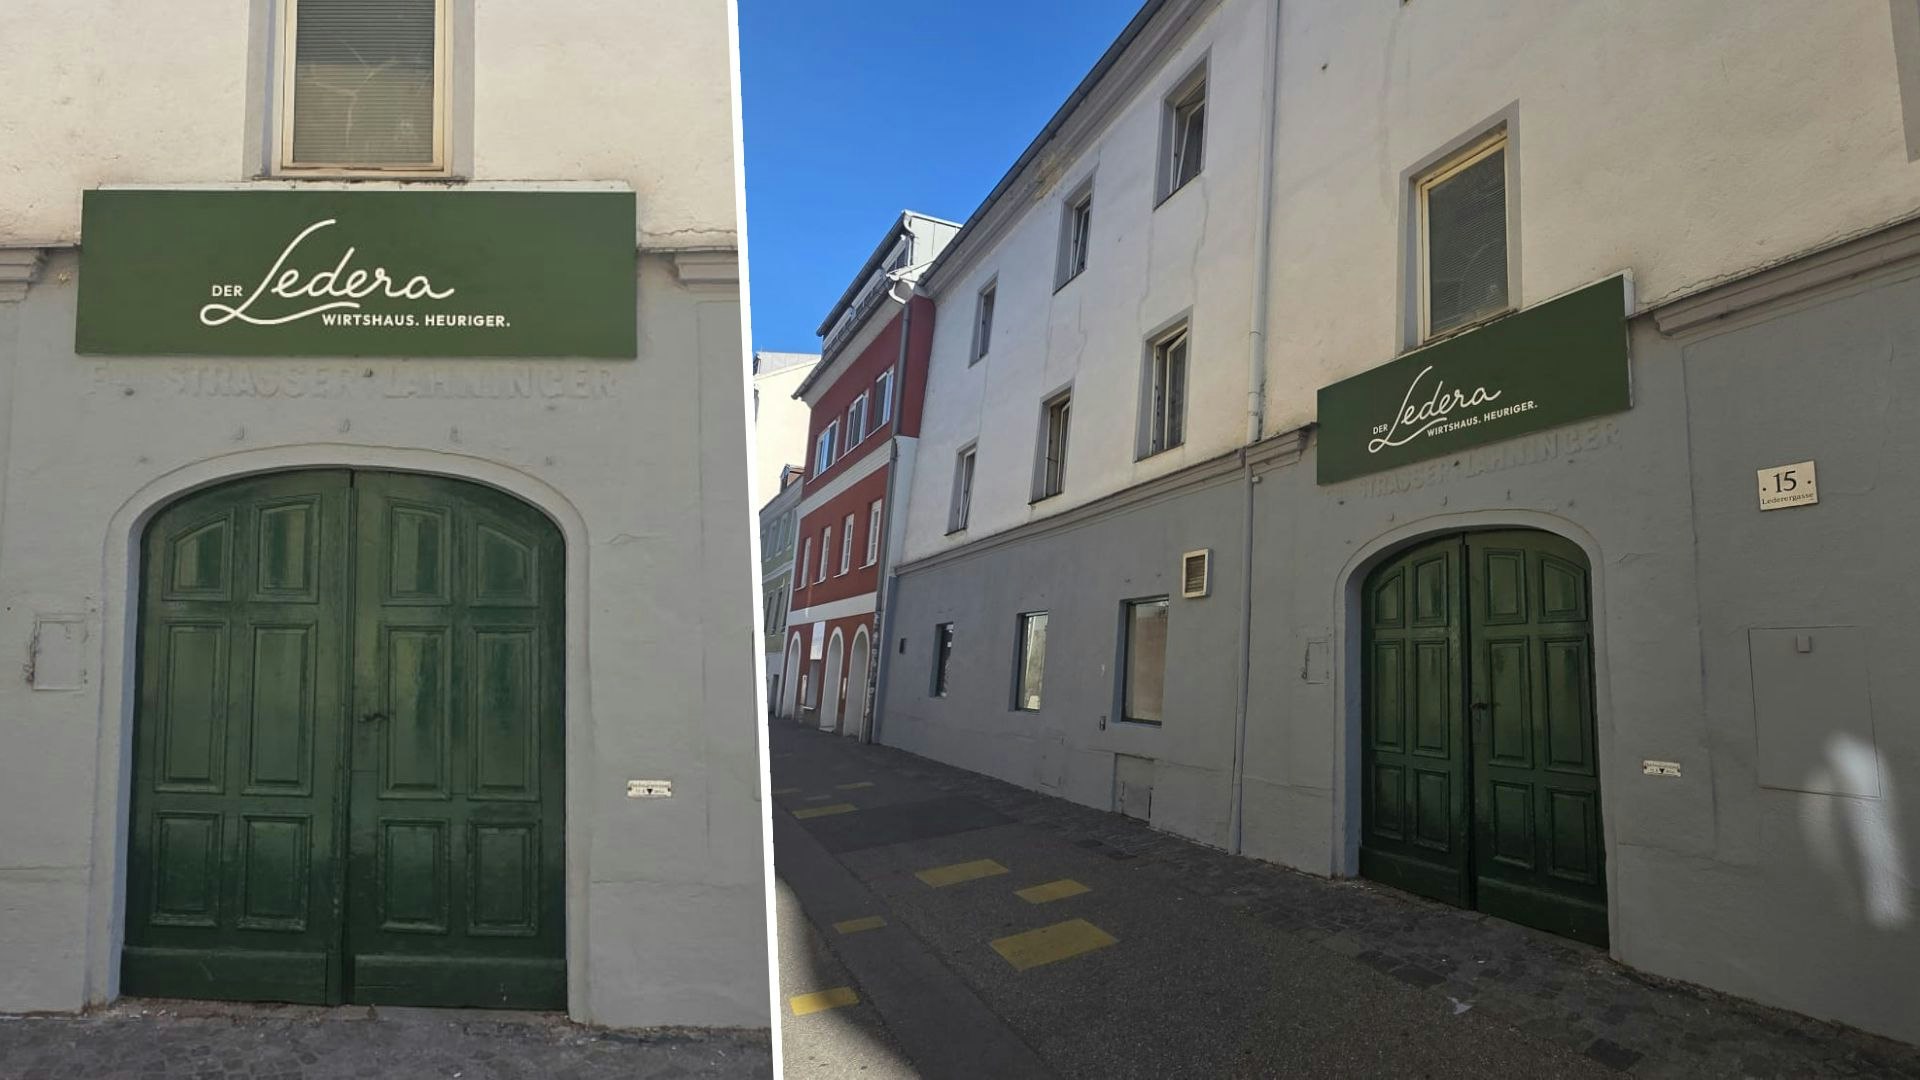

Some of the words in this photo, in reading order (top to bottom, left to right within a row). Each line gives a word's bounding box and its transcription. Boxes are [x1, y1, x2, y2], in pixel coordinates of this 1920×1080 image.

[200, 218, 455, 325] Ledera
[212, 284, 243, 297] DER
[322, 313, 420, 327] WIRTSHAUS.
[425, 314, 511, 328] HEURIGER.
[1368, 365, 1502, 453] Ledera
[1427, 417, 1481, 437] WIRTSHAUS.
[1484, 400, 1538, 422] HEURIGER.
[1372, 424, 1389, 435] DER
[1773, 470, 1797, 493] 15
[1762, 493, 1814, 505] Lederergasse
